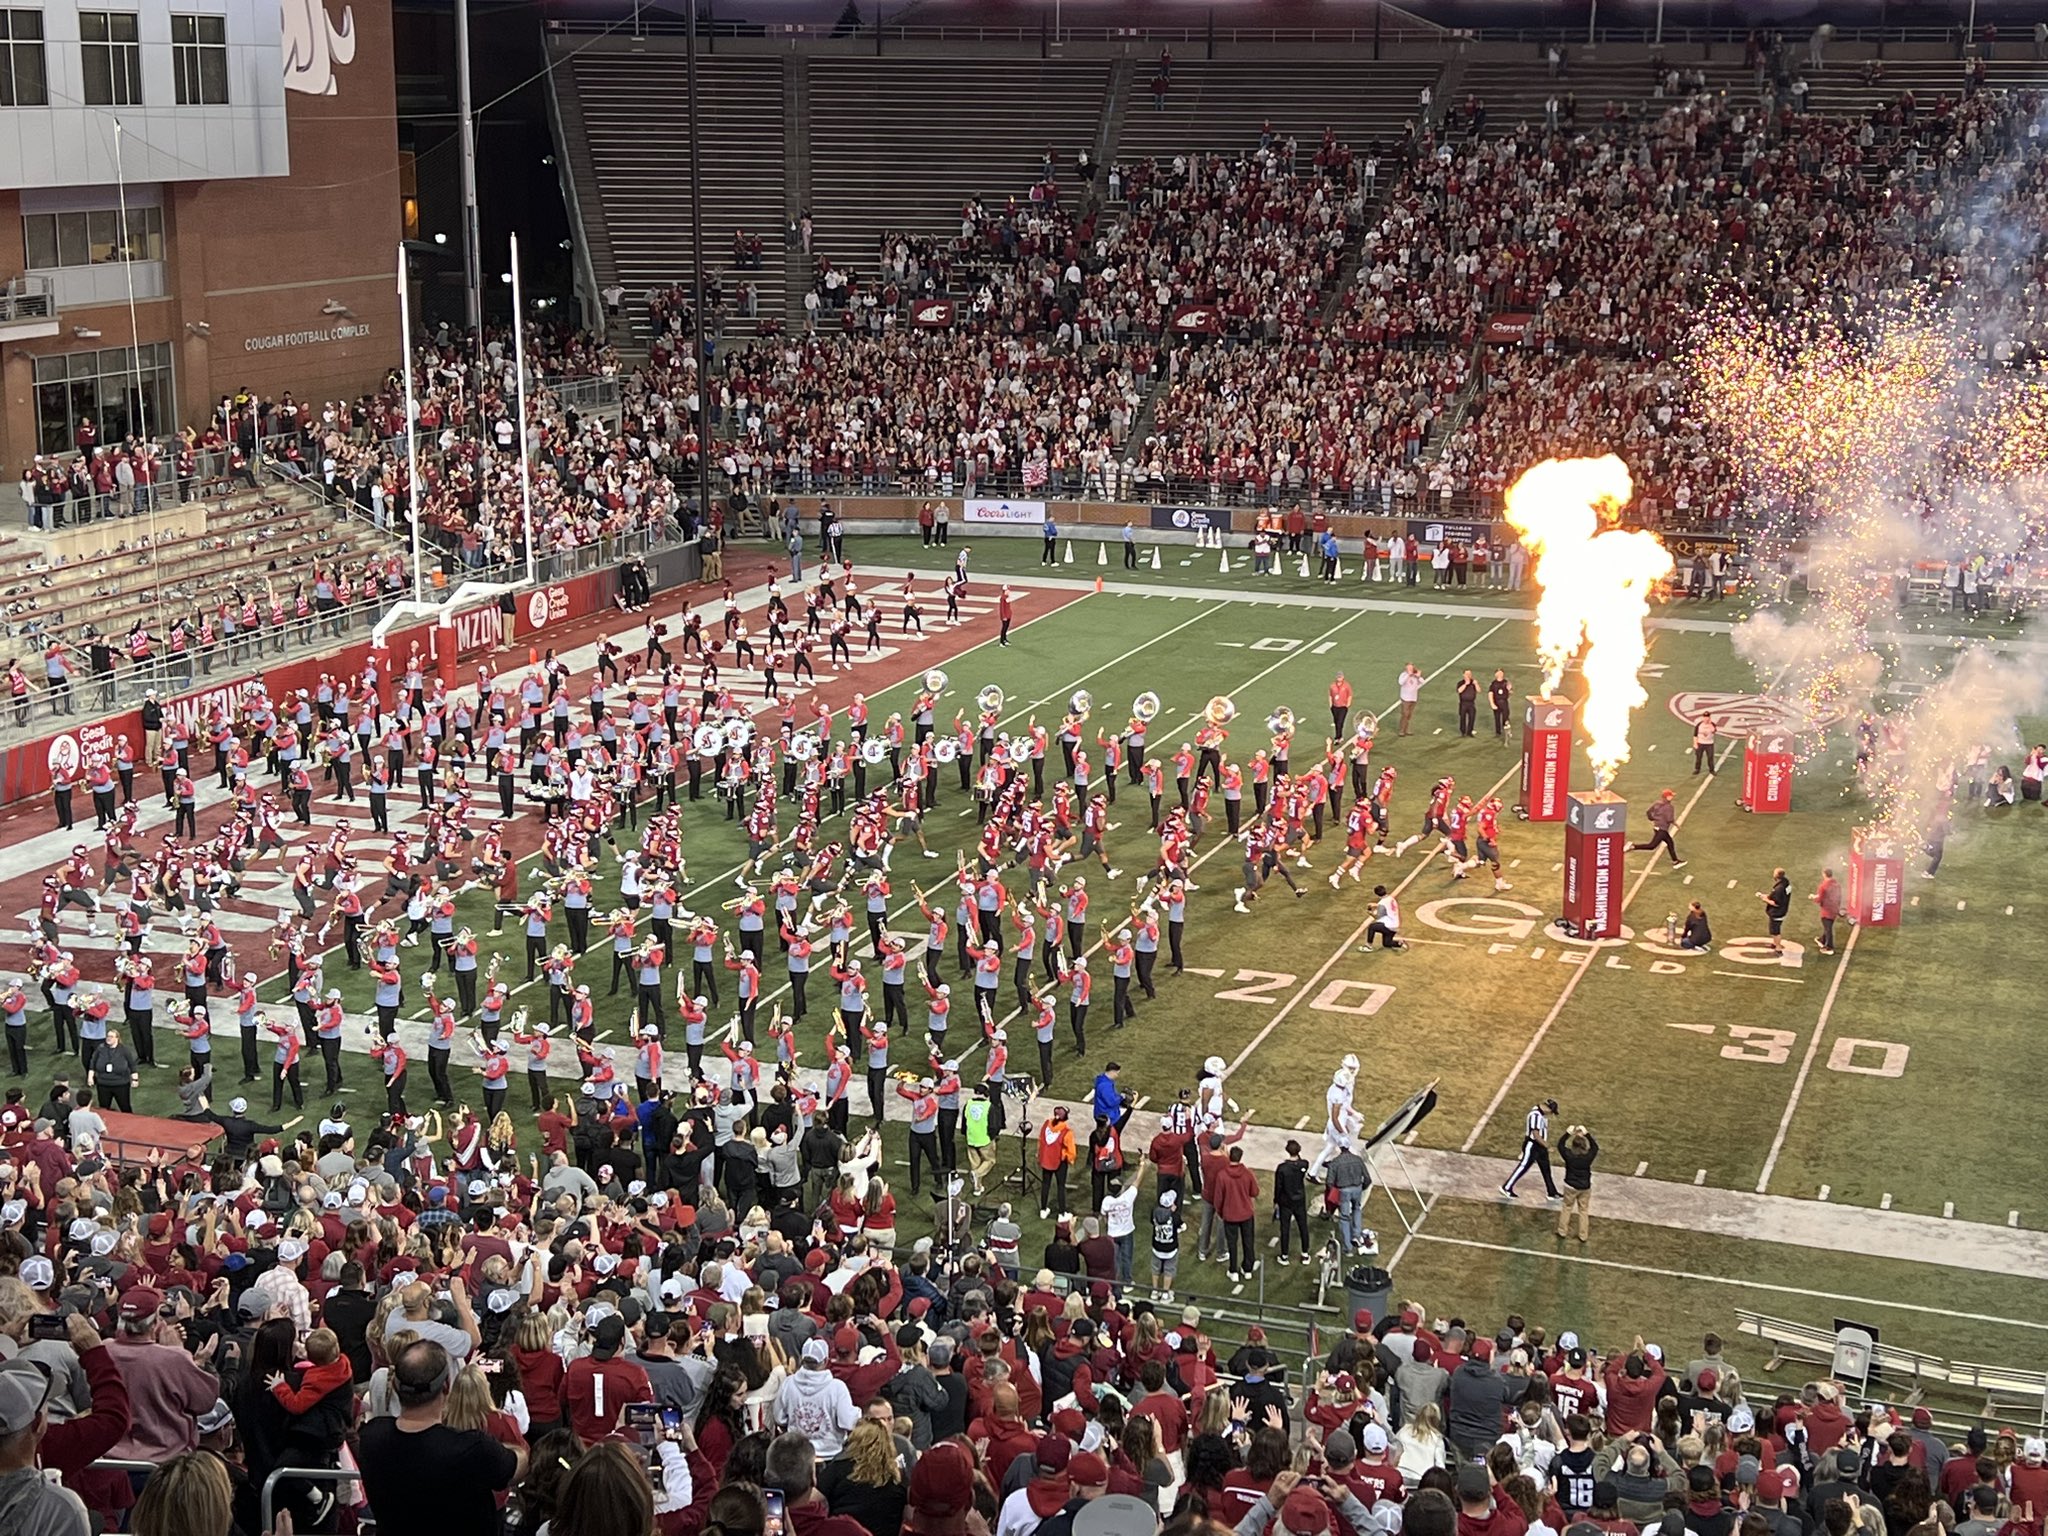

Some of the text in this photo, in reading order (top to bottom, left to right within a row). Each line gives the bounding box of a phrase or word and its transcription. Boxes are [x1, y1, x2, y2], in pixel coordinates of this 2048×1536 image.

[244, 323, 370, 351] COUGAR FOOTBALL COMPLEX
[977, 507, 1032, 519] Coors LIGHT
[80, 726, 106, 741] Gesa
[81, 734, 113, 755] Credit
[1542, 734, 1559, 817] WASHINGTON STATE
[1569, 857, 1577, 904] COUGARS
[1594, 837, 1610, 932] WASHINGTON STATE
[1871, 864, 1887, 922] WASHINGTON
[1886, 878, 1898, 905] STATE
[1488, 942, 1687, 975] FIELD
[1214, 968, 1397, 1016] 20
[1719, 1023, 1911, 1078] 30
[593, 1373, 604, 1417] 1
[1558, 1393, 1579, 1420] 16
[1568, 1478, 1594, 1508] 16
